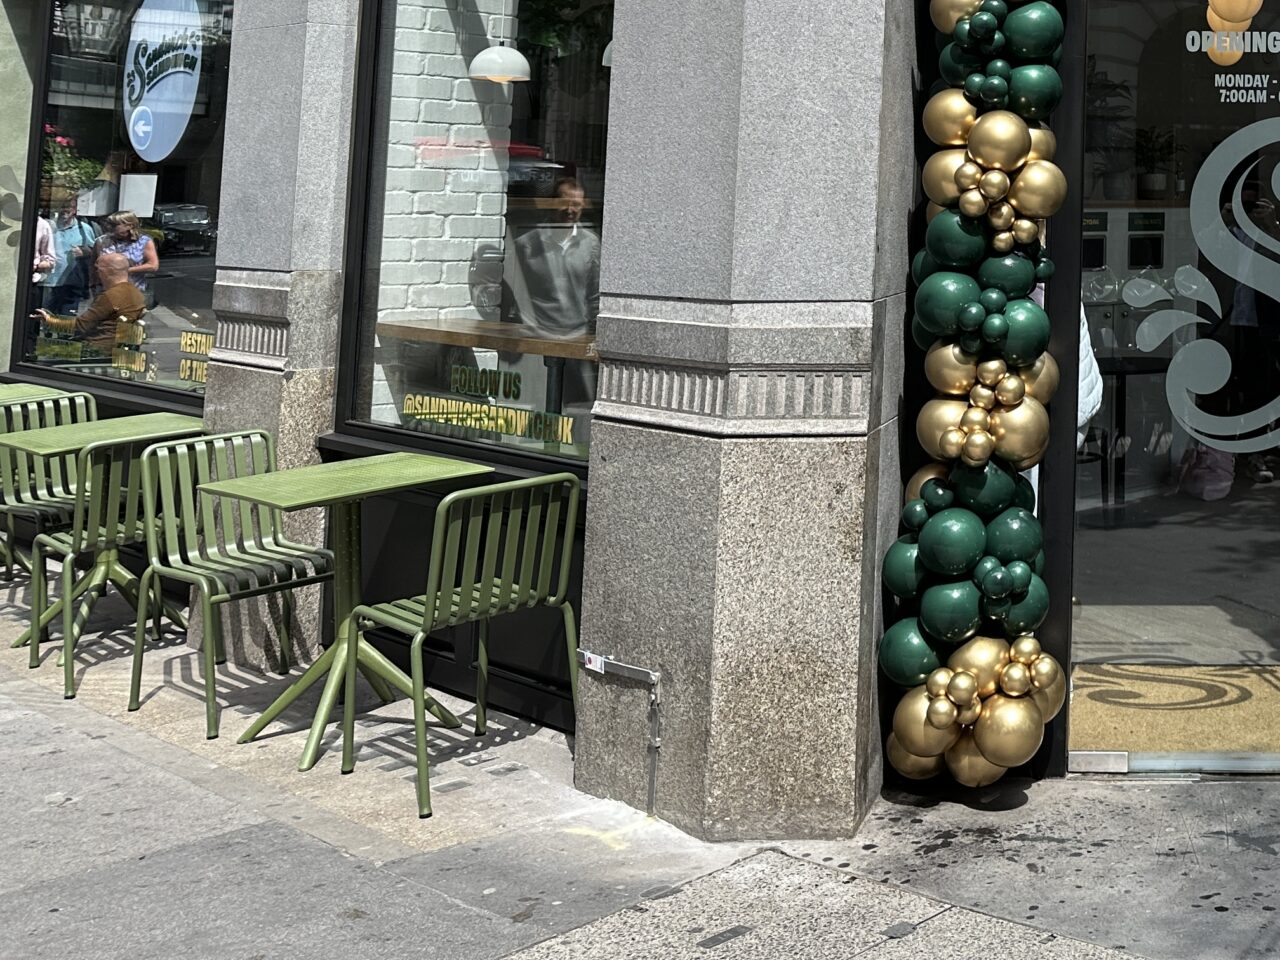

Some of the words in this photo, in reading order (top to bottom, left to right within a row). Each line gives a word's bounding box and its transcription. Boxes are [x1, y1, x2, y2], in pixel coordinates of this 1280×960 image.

[1214, 73, 1270, 88] MONDAY
[1219, 89, 1267, 103] 7:00AM
[180, 330, 214, 355] RESTAU
[179, 358, 191, 381] OF
[451, 364, 500, 398] FOLLOW
[502, 371, 522, 401] US
[403, 393, 574, 445] @SANDWICHSANDWICHUK
